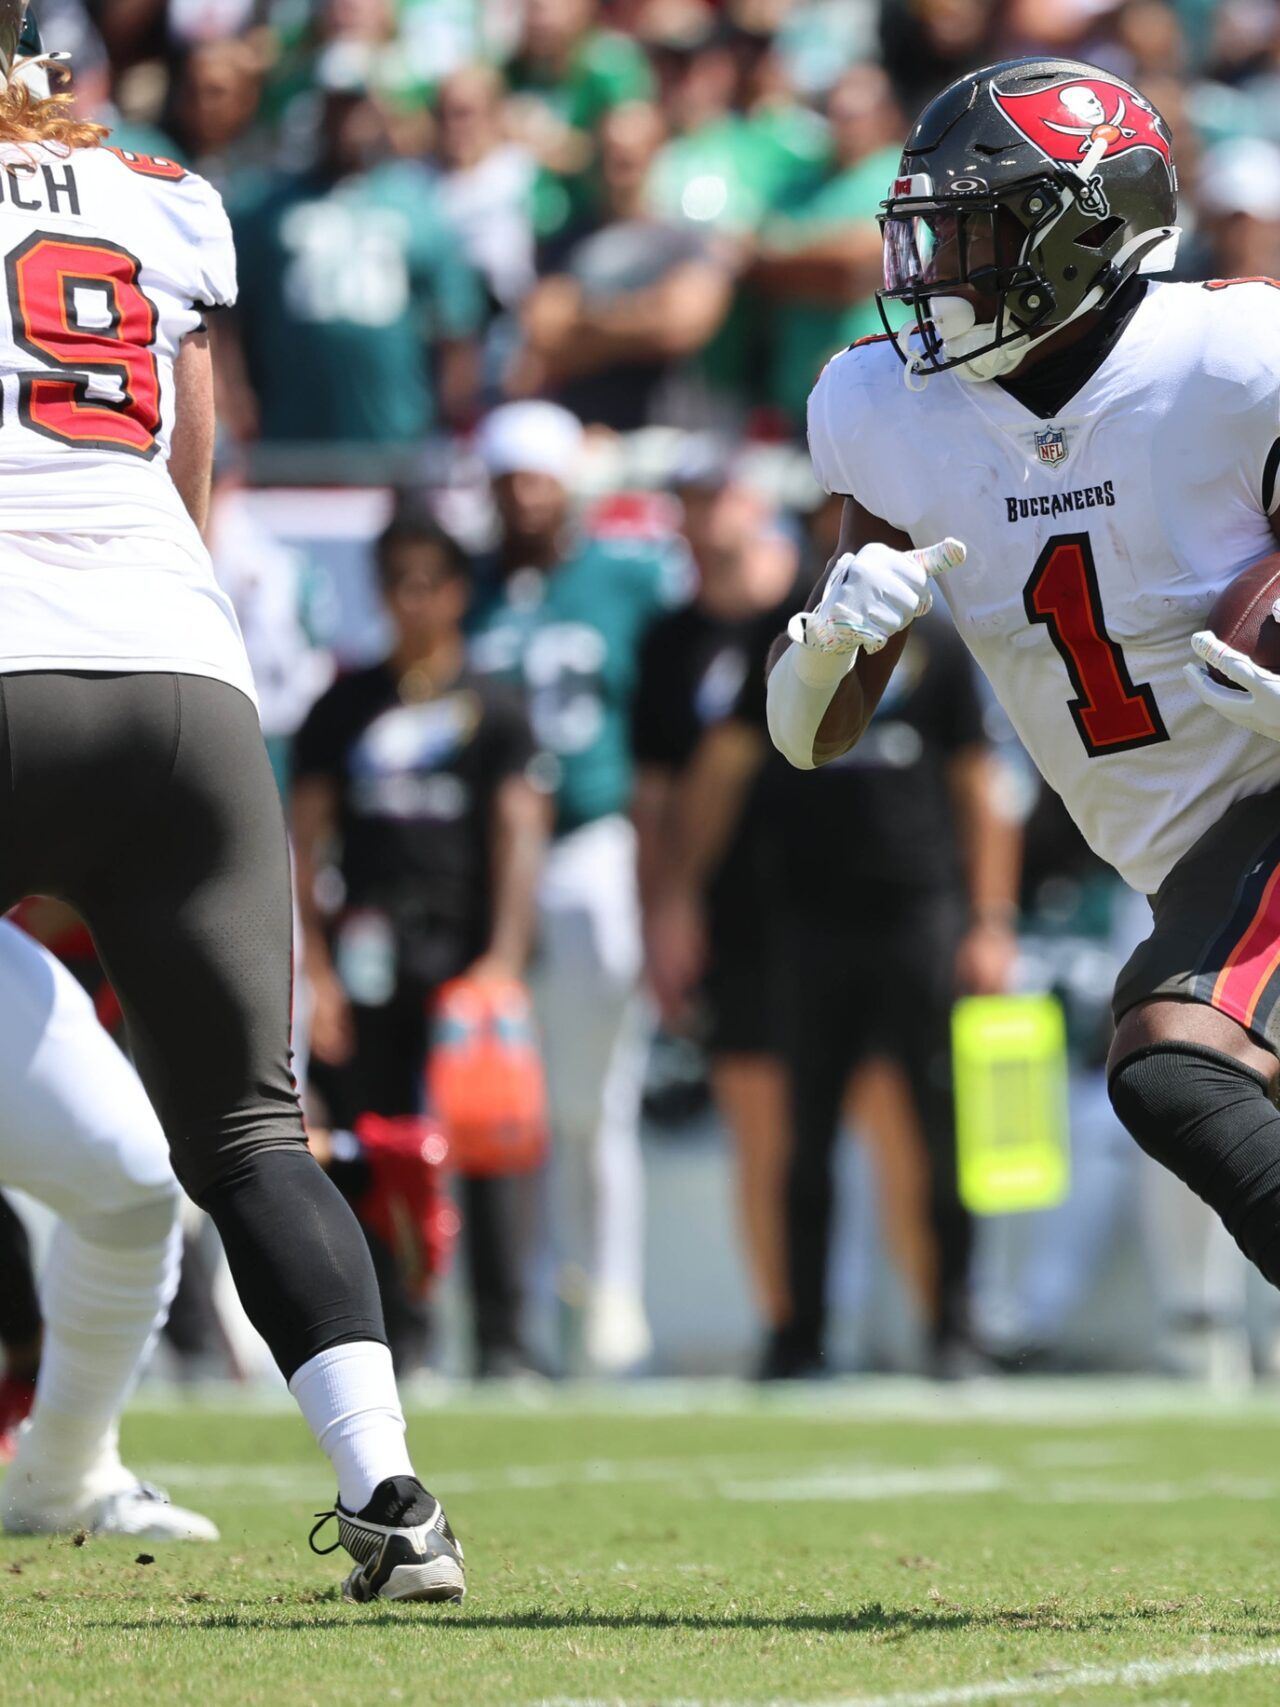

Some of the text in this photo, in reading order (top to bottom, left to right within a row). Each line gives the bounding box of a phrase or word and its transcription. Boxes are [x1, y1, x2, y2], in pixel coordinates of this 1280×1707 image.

[0, 163, 81, 216] CH
[0, 229, 162, 462] 9
[1040, 443, 1063, 460] NFL
[1004, 480, 1115, 523] BUCCANEERS
[1022, 531, 1171, 758] 1
